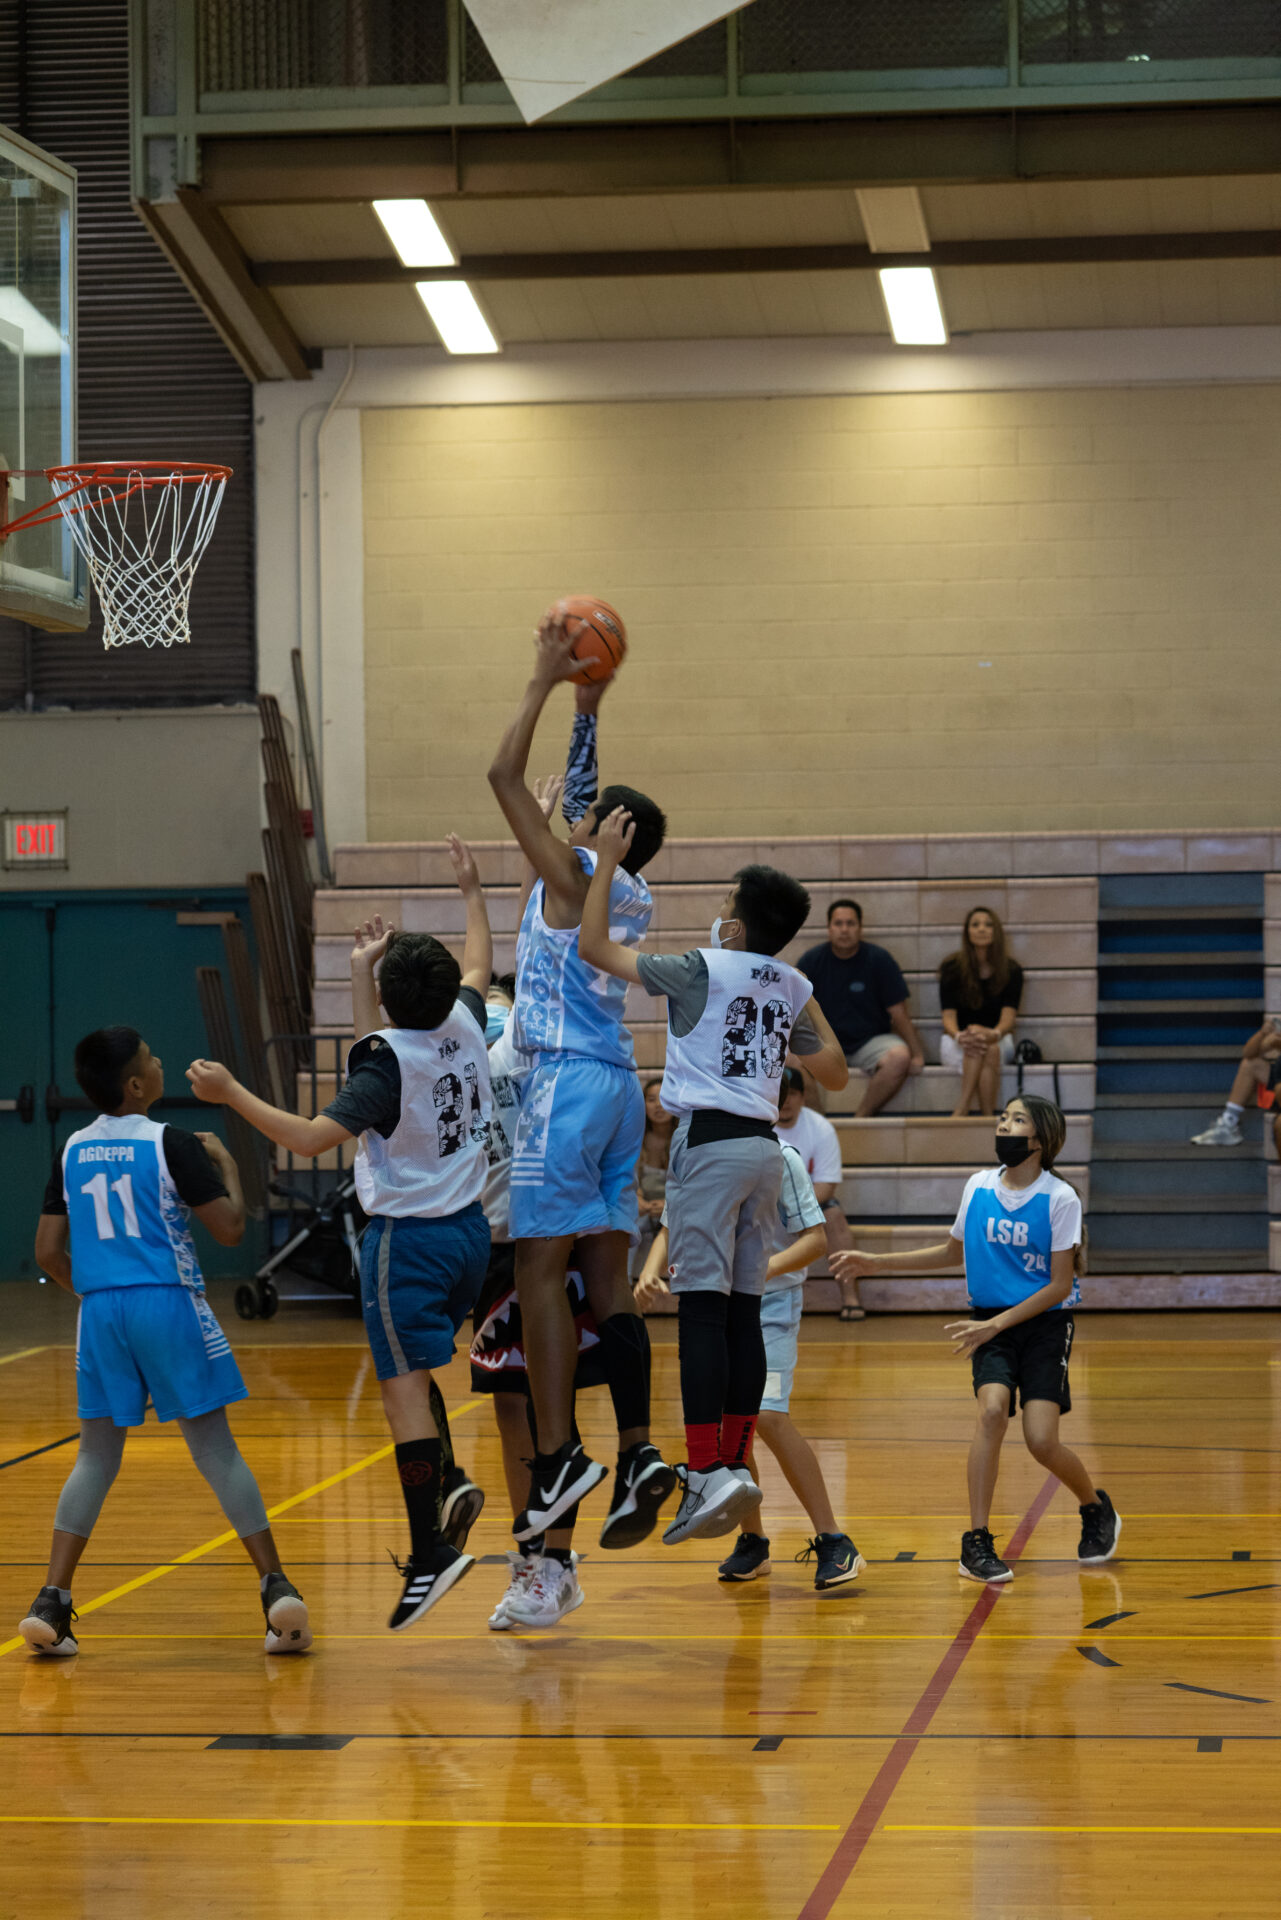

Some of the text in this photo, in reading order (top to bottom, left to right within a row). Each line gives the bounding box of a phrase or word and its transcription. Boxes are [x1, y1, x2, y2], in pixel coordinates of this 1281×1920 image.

[16, 824, 57, 855] EXIT
[750, 968, 782, 984] PAL
[438, 1040, 461, 1059] PAL
[721, 996, 793, 1079] 26
[78, 1145, 135, 1163] AGDEPPA
[81, 1173, 141, 1241] 11
[987, 1217, 1029, 1246] LSB
[1022, 1252, 1047, 1272] 24
